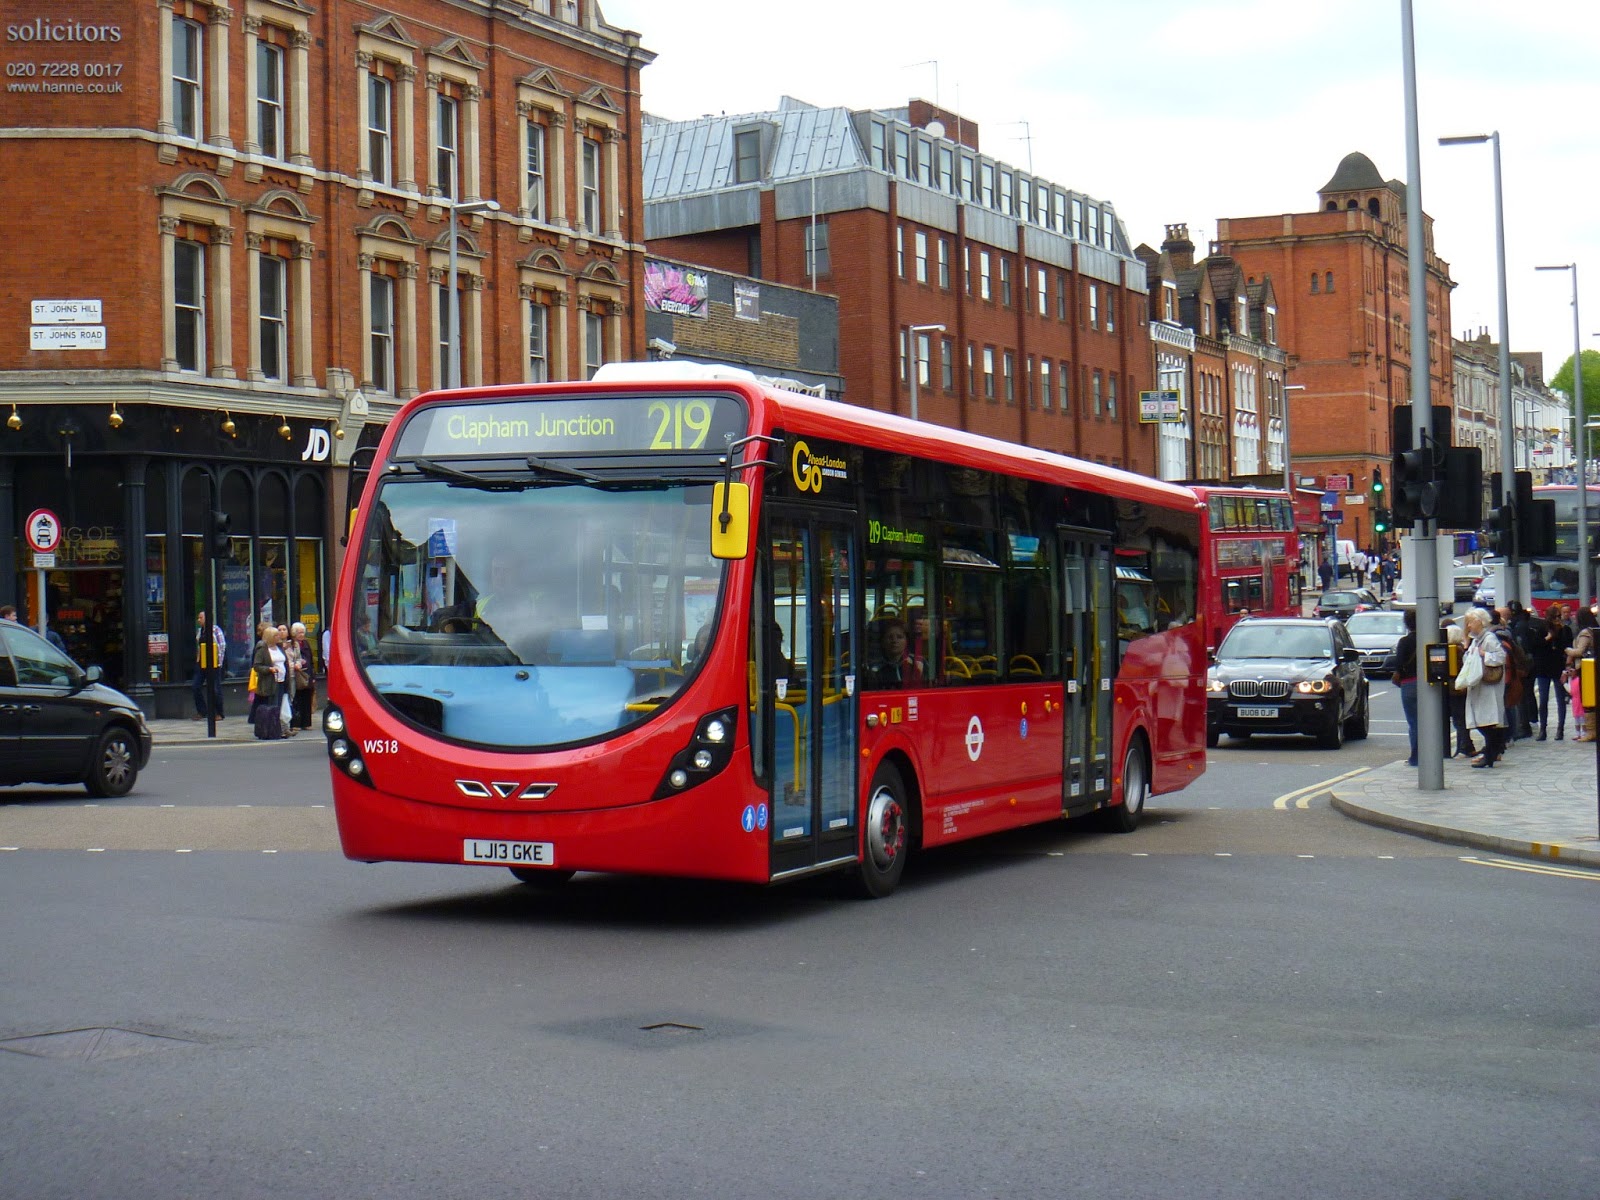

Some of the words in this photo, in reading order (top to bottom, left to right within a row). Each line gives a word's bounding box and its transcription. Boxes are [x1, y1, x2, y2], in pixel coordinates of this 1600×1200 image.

[7, 18, 121, 42] solicitors
[6, 63, 36, 77] 020
[40, 63, 80, 77] 7228
[84, 63, 123, 77] 0017
[7, 81, 123, 93] www.hanne.co.uk
[34, 305, 48, 313] ST.
[50, 305, 78, 313] JOHNS
[81, 305, 98, 313] HILL
[33, 332, 46, 340] ST.
[80, 331, 103, 339] ROAD
[448, 414, 529, 445] Clapham
[535, 412, 614, 437] Junction
[648, 400, 711, 450] 219
[302, 428, 330, 462] JD
[792, 441, 822, 493] Go
[87, 526, 114, 541] OF
[869, 519, 880, 544] 219
[364, 739, 398, 754] WS18
[473, 842, 508, 859] LJ13
[512, 844, 543, 861] GKE
